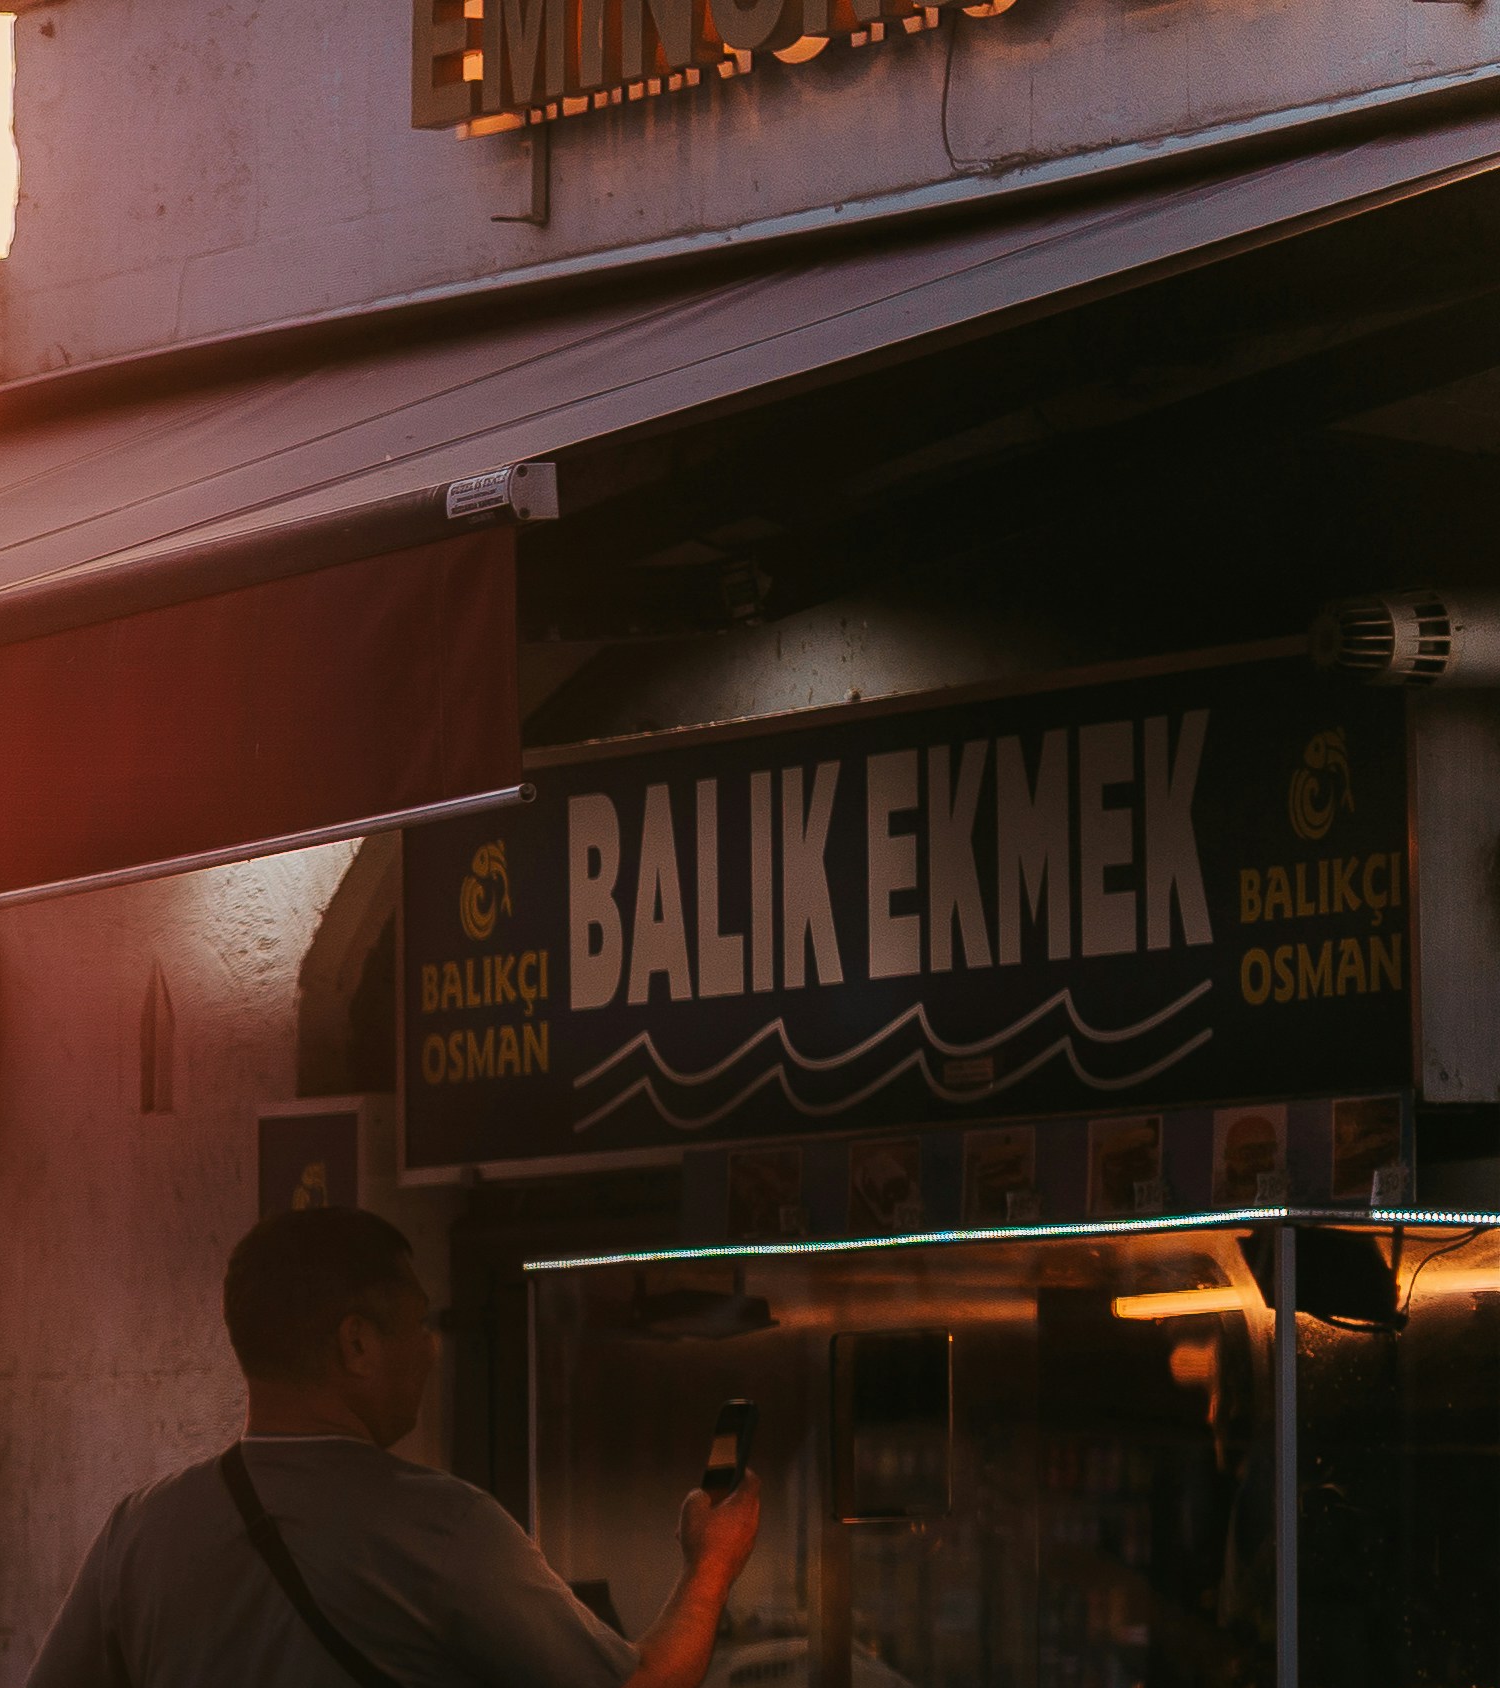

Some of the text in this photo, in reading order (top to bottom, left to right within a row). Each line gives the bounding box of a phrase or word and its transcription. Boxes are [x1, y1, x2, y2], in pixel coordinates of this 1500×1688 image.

[568, 708, 1213, 1012] BALIK EKMEK
[1240, 850, 1401, 928] BALIKÇI
[421, 948, 549, 1016] BALIKÇI
[1240, 935, 1403, 1006] OSMAN
[421, 1022, 550, 1085] OSMAN
